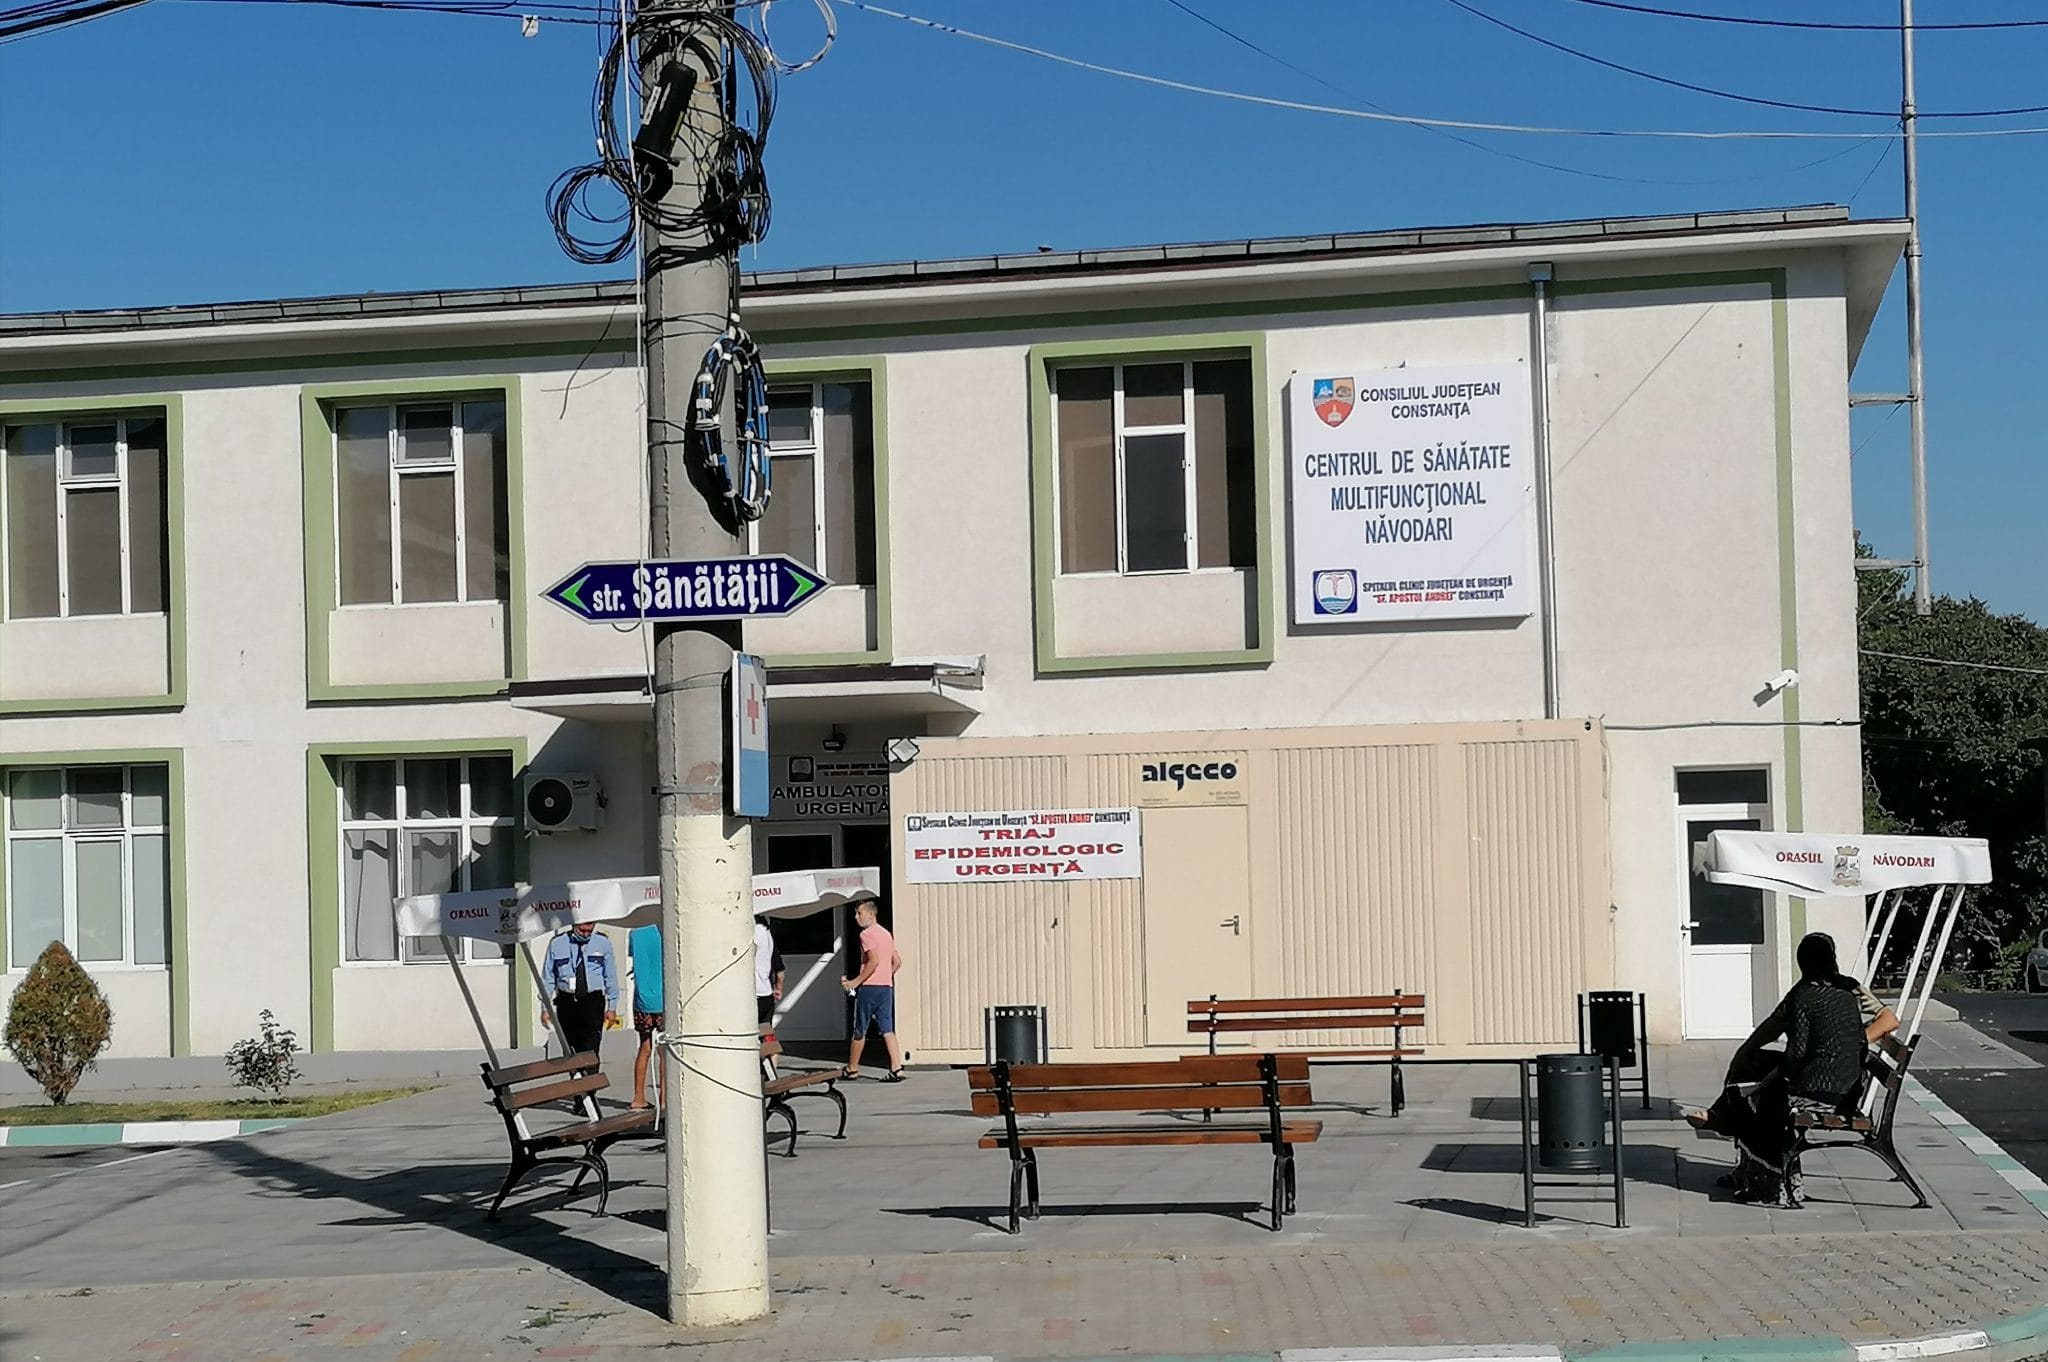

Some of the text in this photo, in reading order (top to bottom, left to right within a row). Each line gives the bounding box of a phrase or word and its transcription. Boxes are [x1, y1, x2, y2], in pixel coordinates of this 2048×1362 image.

[1361, 388, 1429, 402] CONSILIUL
[1305, 441, 1511, 478] CENTRUL DE SĂNĂTATE
[1365, 514, 1453, 544] NĂVODARI
[592, 584, 626, 612] str.
[1142, 762, 1237, 791] algeco
[979, 828, 1056, 841] TRIAJ
[915, 844, 1124, 860] EPIDEMIOLOGIC
